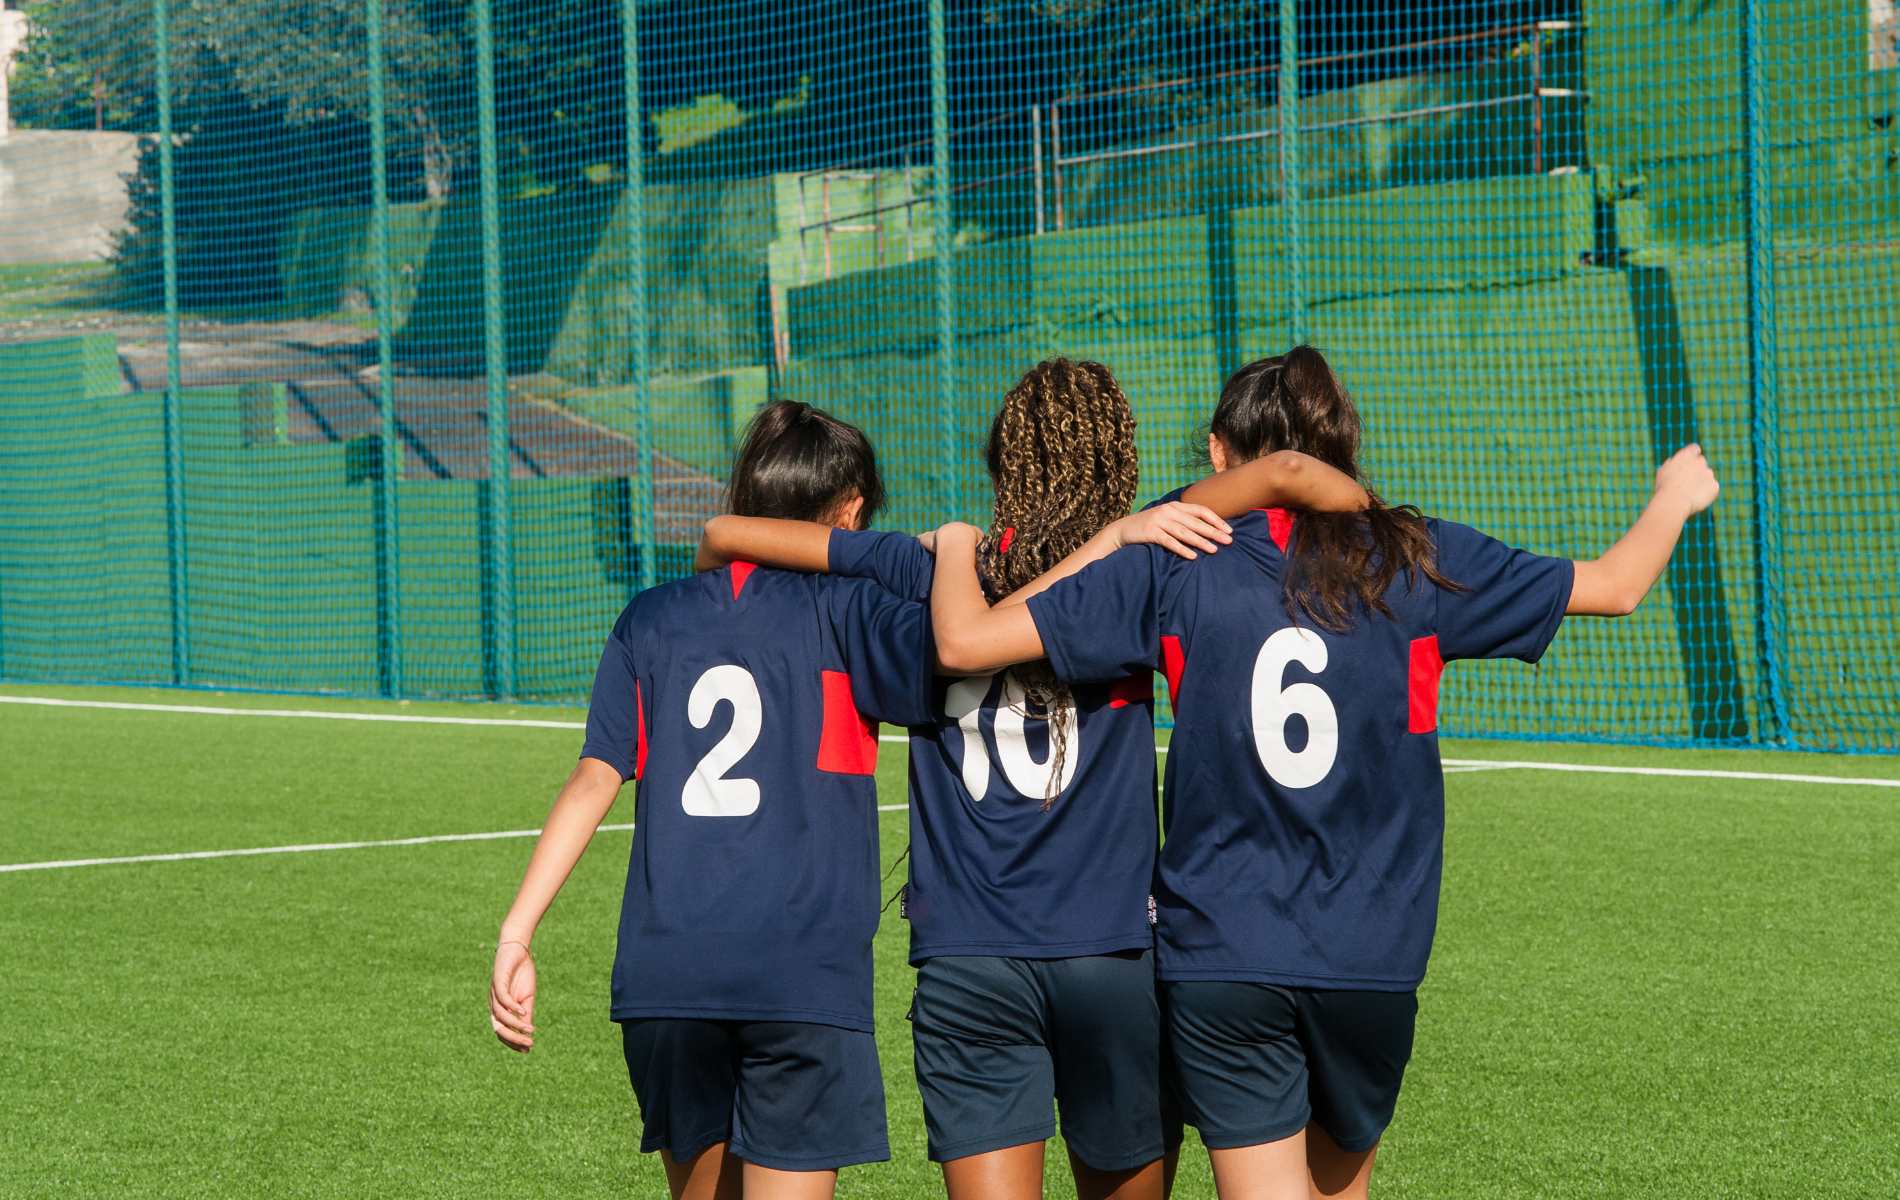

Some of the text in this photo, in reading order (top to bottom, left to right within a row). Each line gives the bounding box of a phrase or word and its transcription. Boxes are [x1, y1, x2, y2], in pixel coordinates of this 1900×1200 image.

[681, 664, 763, 817] 2
[945, 670, 1079, 802] 10
[1250, 626, 1339, 789] 6
